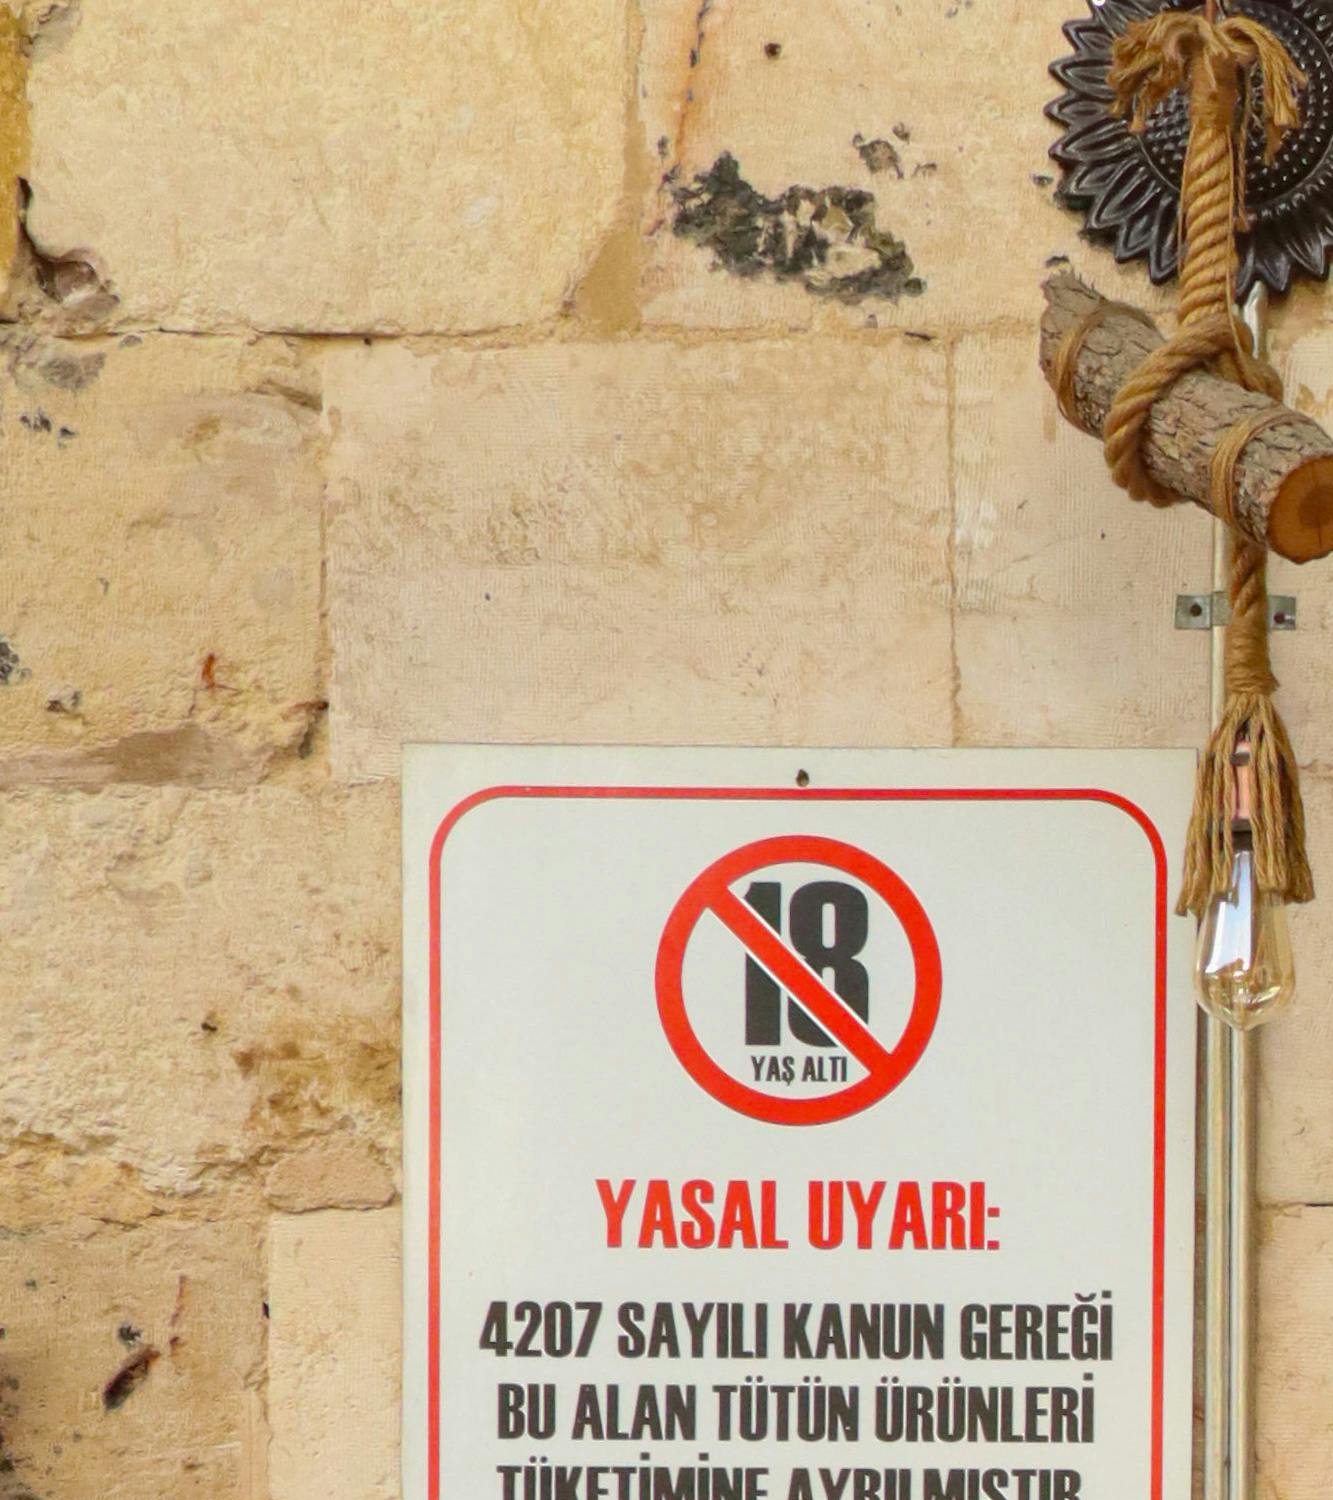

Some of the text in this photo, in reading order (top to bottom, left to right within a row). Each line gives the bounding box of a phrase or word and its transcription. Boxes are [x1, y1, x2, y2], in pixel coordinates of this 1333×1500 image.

[744, 881, 869, 1048] 18
[751, 1056, 847, 1086] YAŞ ALTI
[596, 1179, 1000, 1250] YASAL UYARI:
[480, 1290, 1113, 1361] 4207 SAYILI KANUN GEREĞİ
[498, 1373, 1094, 1443] BU ALAN TÜTÜN ÜRÜNLERİ
